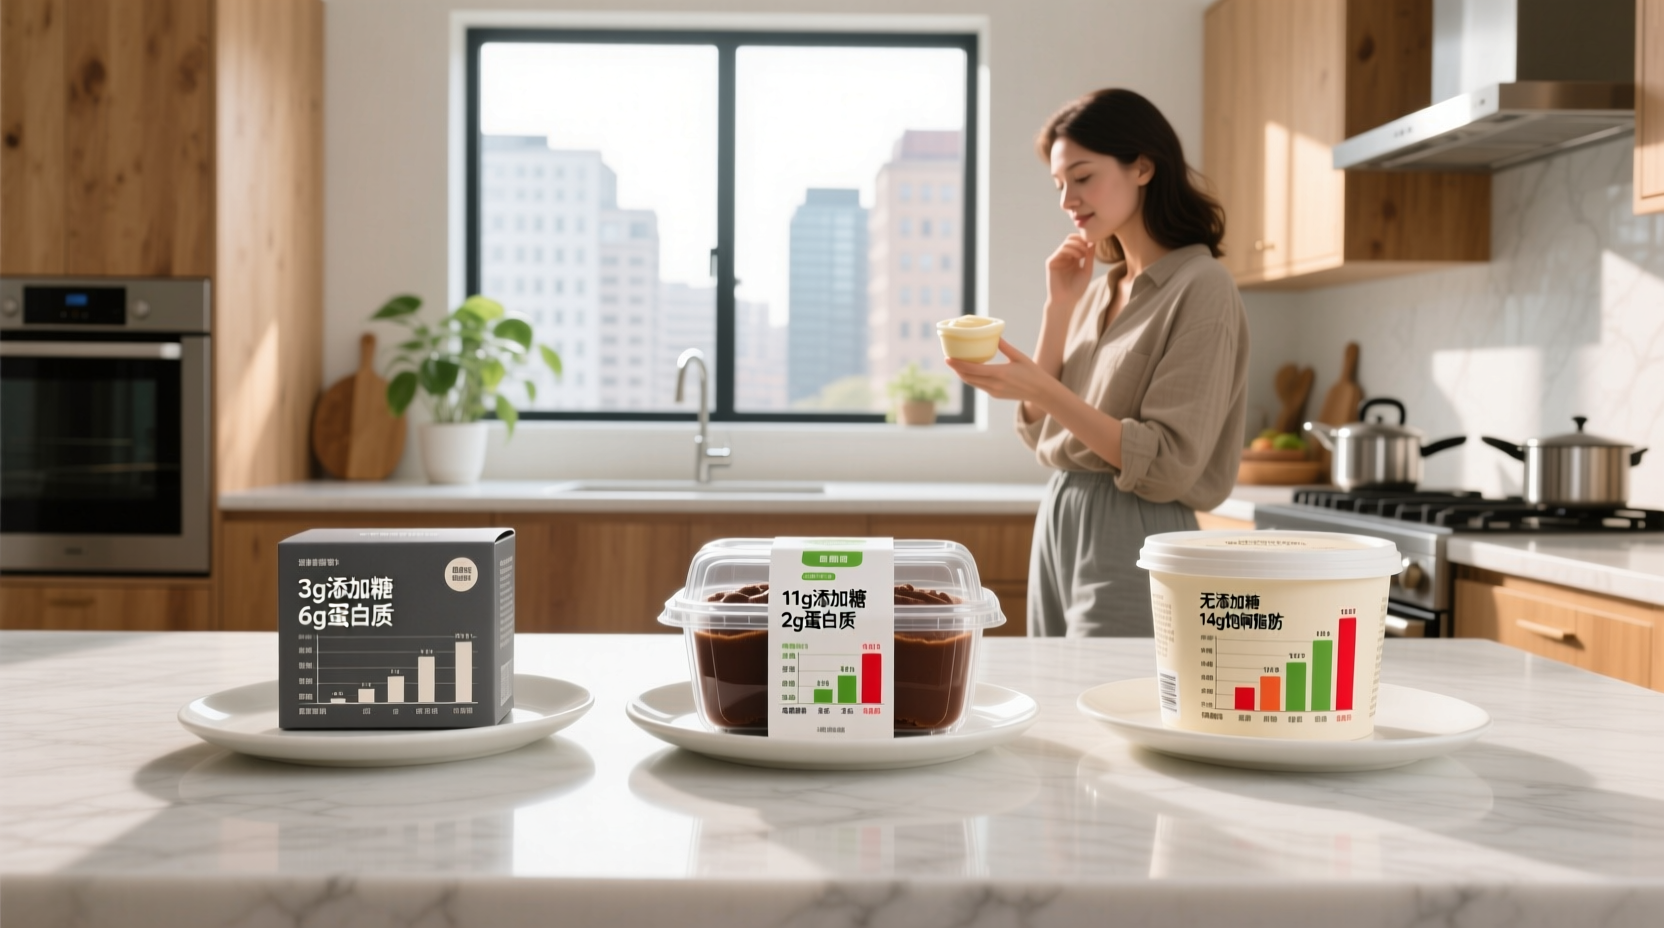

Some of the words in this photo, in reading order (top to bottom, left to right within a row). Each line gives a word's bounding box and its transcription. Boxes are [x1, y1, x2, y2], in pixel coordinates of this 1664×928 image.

[298, 576, 394, 604] 3g添加糖
[782, 589, 867, 609] 11g添加糖
[1199, 592, 1261, 610] 无添加糖
[298, 603, 395, 630] 6g蛋白质
[781, 610, 857, 632] 2g蛋白质
